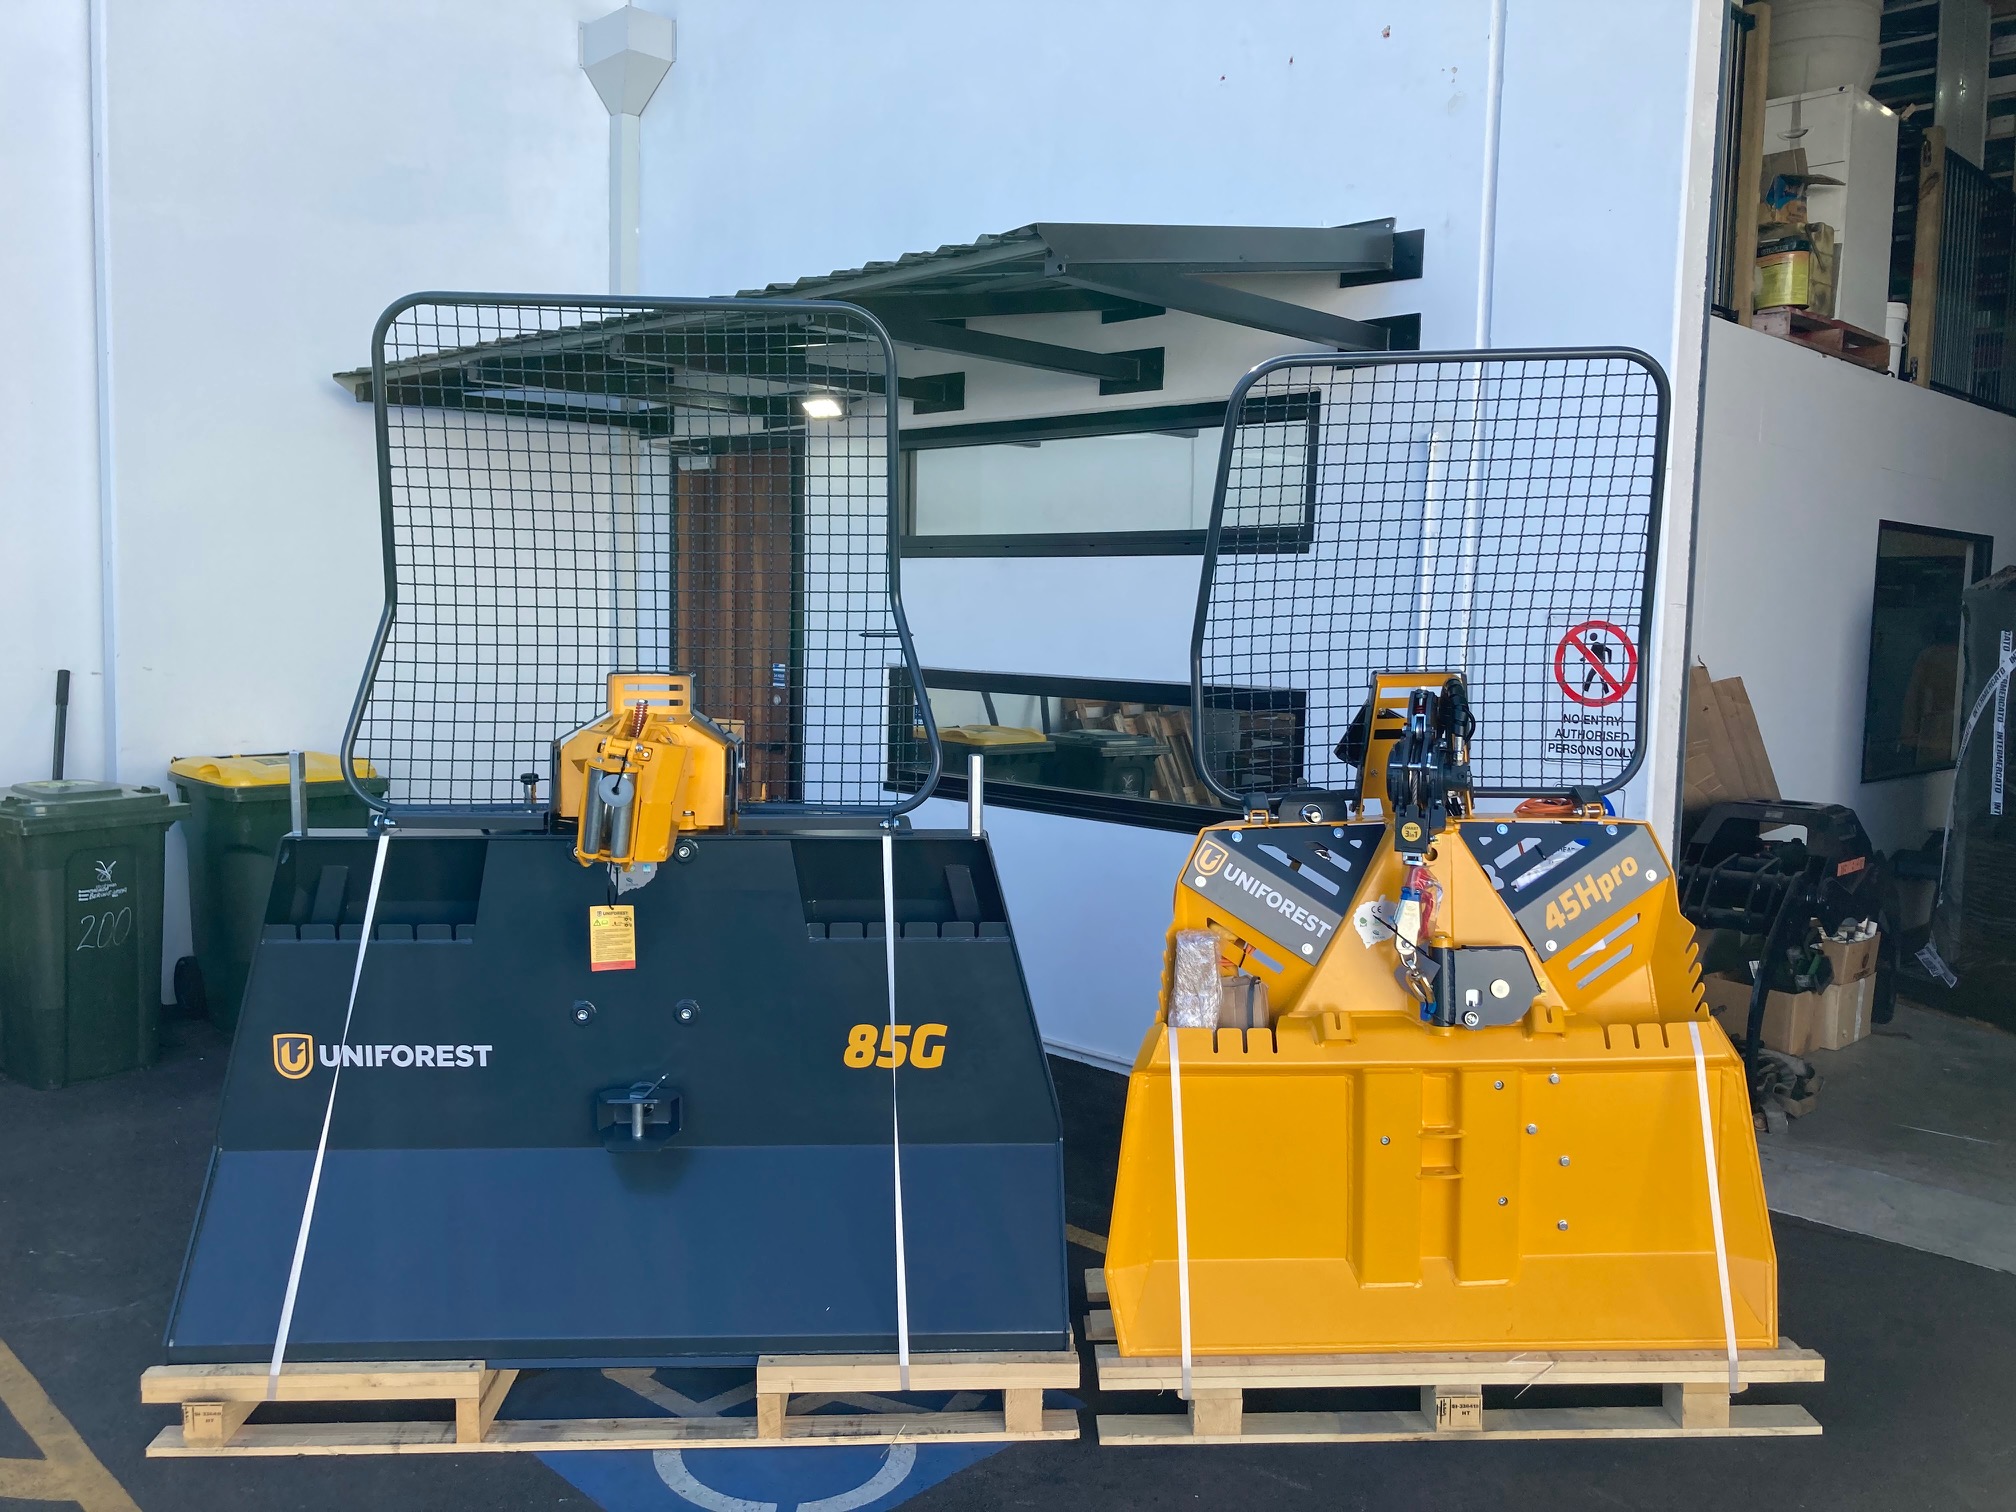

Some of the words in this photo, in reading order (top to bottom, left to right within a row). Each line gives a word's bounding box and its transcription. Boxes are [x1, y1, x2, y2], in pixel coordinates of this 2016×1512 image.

[1555, 728, 1630, 741] AUTHORISED
[1563, 714, 1580, 724] NO
[1583, 715, 1622, 726] ENTRY
[1548, 742, 1603, 756] PERSONS
[1605, 746, 1635, 758] ONLY
[1994, 731, 2003, 794] INTERMERCATO
[1223, 862, 1332, 939] UNIFOREST
[1545, 856, 1639, 930] 45Hpro
[77, 906, 132, 951] 200
[319, 1044, 493, 1068] UNIFOREST
[843, 1023, 948, 1069] 85G
